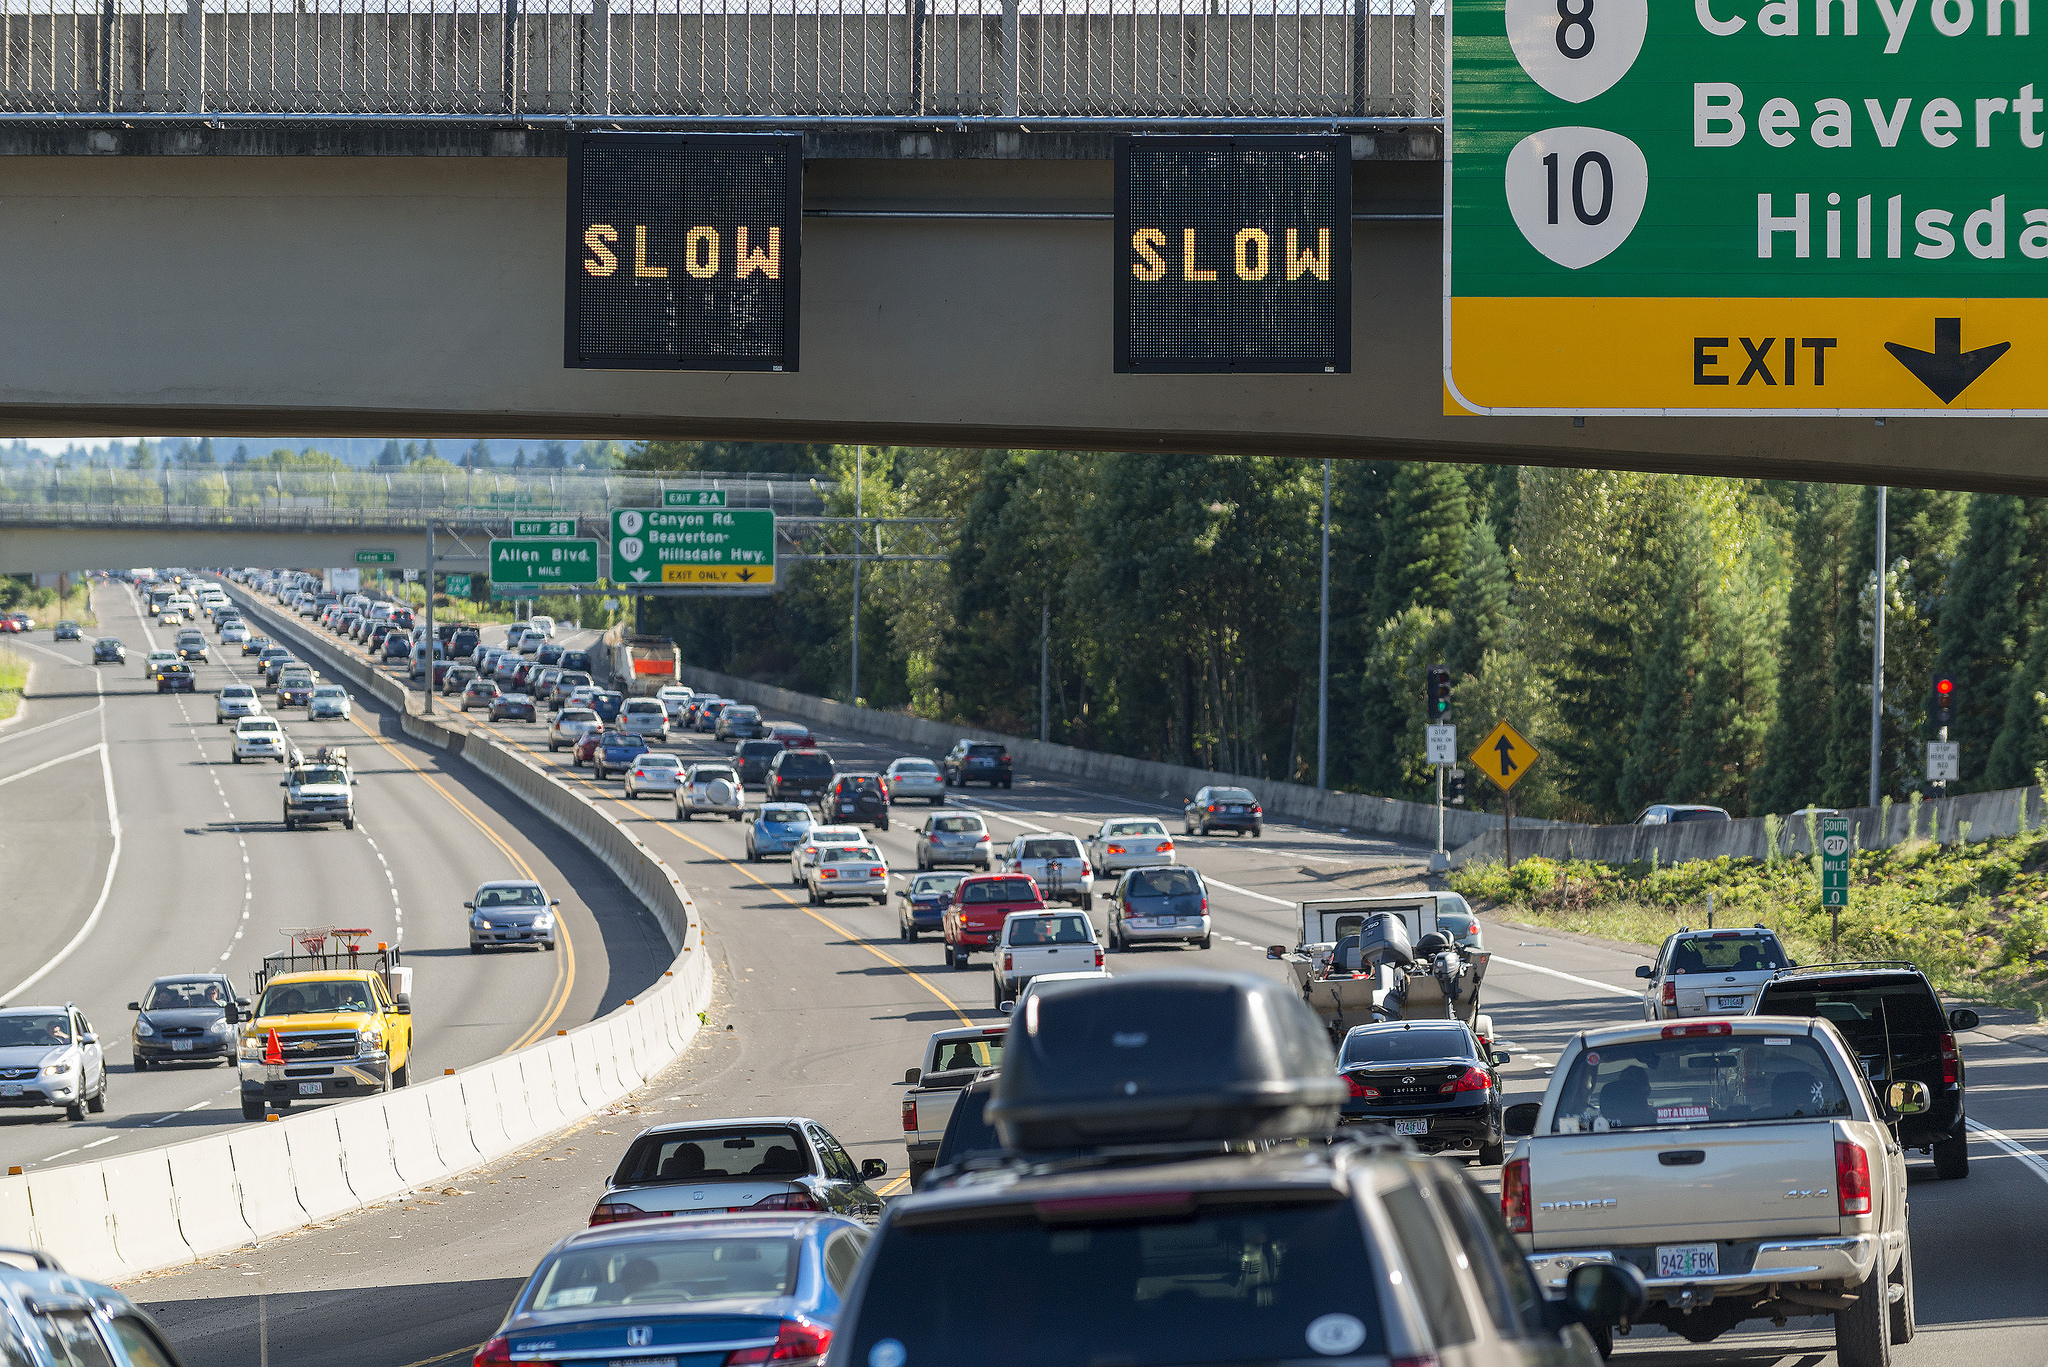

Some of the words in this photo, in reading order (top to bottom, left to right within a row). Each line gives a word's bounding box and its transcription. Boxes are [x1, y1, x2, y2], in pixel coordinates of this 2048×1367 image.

[1555, 0, 1596, 59] 8
[1695, 0, 2030, 54] Canyon
[1693, 82, 2045, 148] Beavert
[1542, 151, 1614, 225] 10
[584, 224, 780, 279] SLOW
[1132, 227, 1330, 281] SLOW
[1693, 336, 1838, 386] EXIT
[668, 492, 692, 504] EXIT
[698, 492, 721, 504] 2A
[648, 512, 705, 529] Canyon
[712, 512, 736, 526] Rd.
[519, 523, 542, 534] EXIT
[548, 522, 569, 535] 2B
[648, 530, 730, 544] Beaverton-
[498, 547, 540, 562] Allen
[551, 547, 591, 562] Blvd.
[624, 541, 638, 555] 10
[658, 547, 723, 561] Hillsdale
[730, 547, 767, 564] Hwy.
[526, 565, 533, 577] 1
[538, 566, 562, 577] MILE
[668, 570, 692, 581] EXIT
[698, 570, 728, 580] ONLY
[1824, 819, 1848, 831] SOUTH
[1827, 839, 1844, 850] 217
[1824, 860, 1847, 871] MILE
[1832, 872, 1838, 886] 1
[1657, 1109, 1673, 1118] NOT
[1673, 1108, 1679, 1117] A
[1679, 1106, 1709, 1117] LIBERAL
[1396, 1122, 1409, 1131] 274
[1412, 1121, 1426, 1130] FUZ
[1539, 1198, 1617, 1213] DODGE
[1661, 1254, 1685, 1270] 942
[1691, 1251, 1715, 1270] FBK
